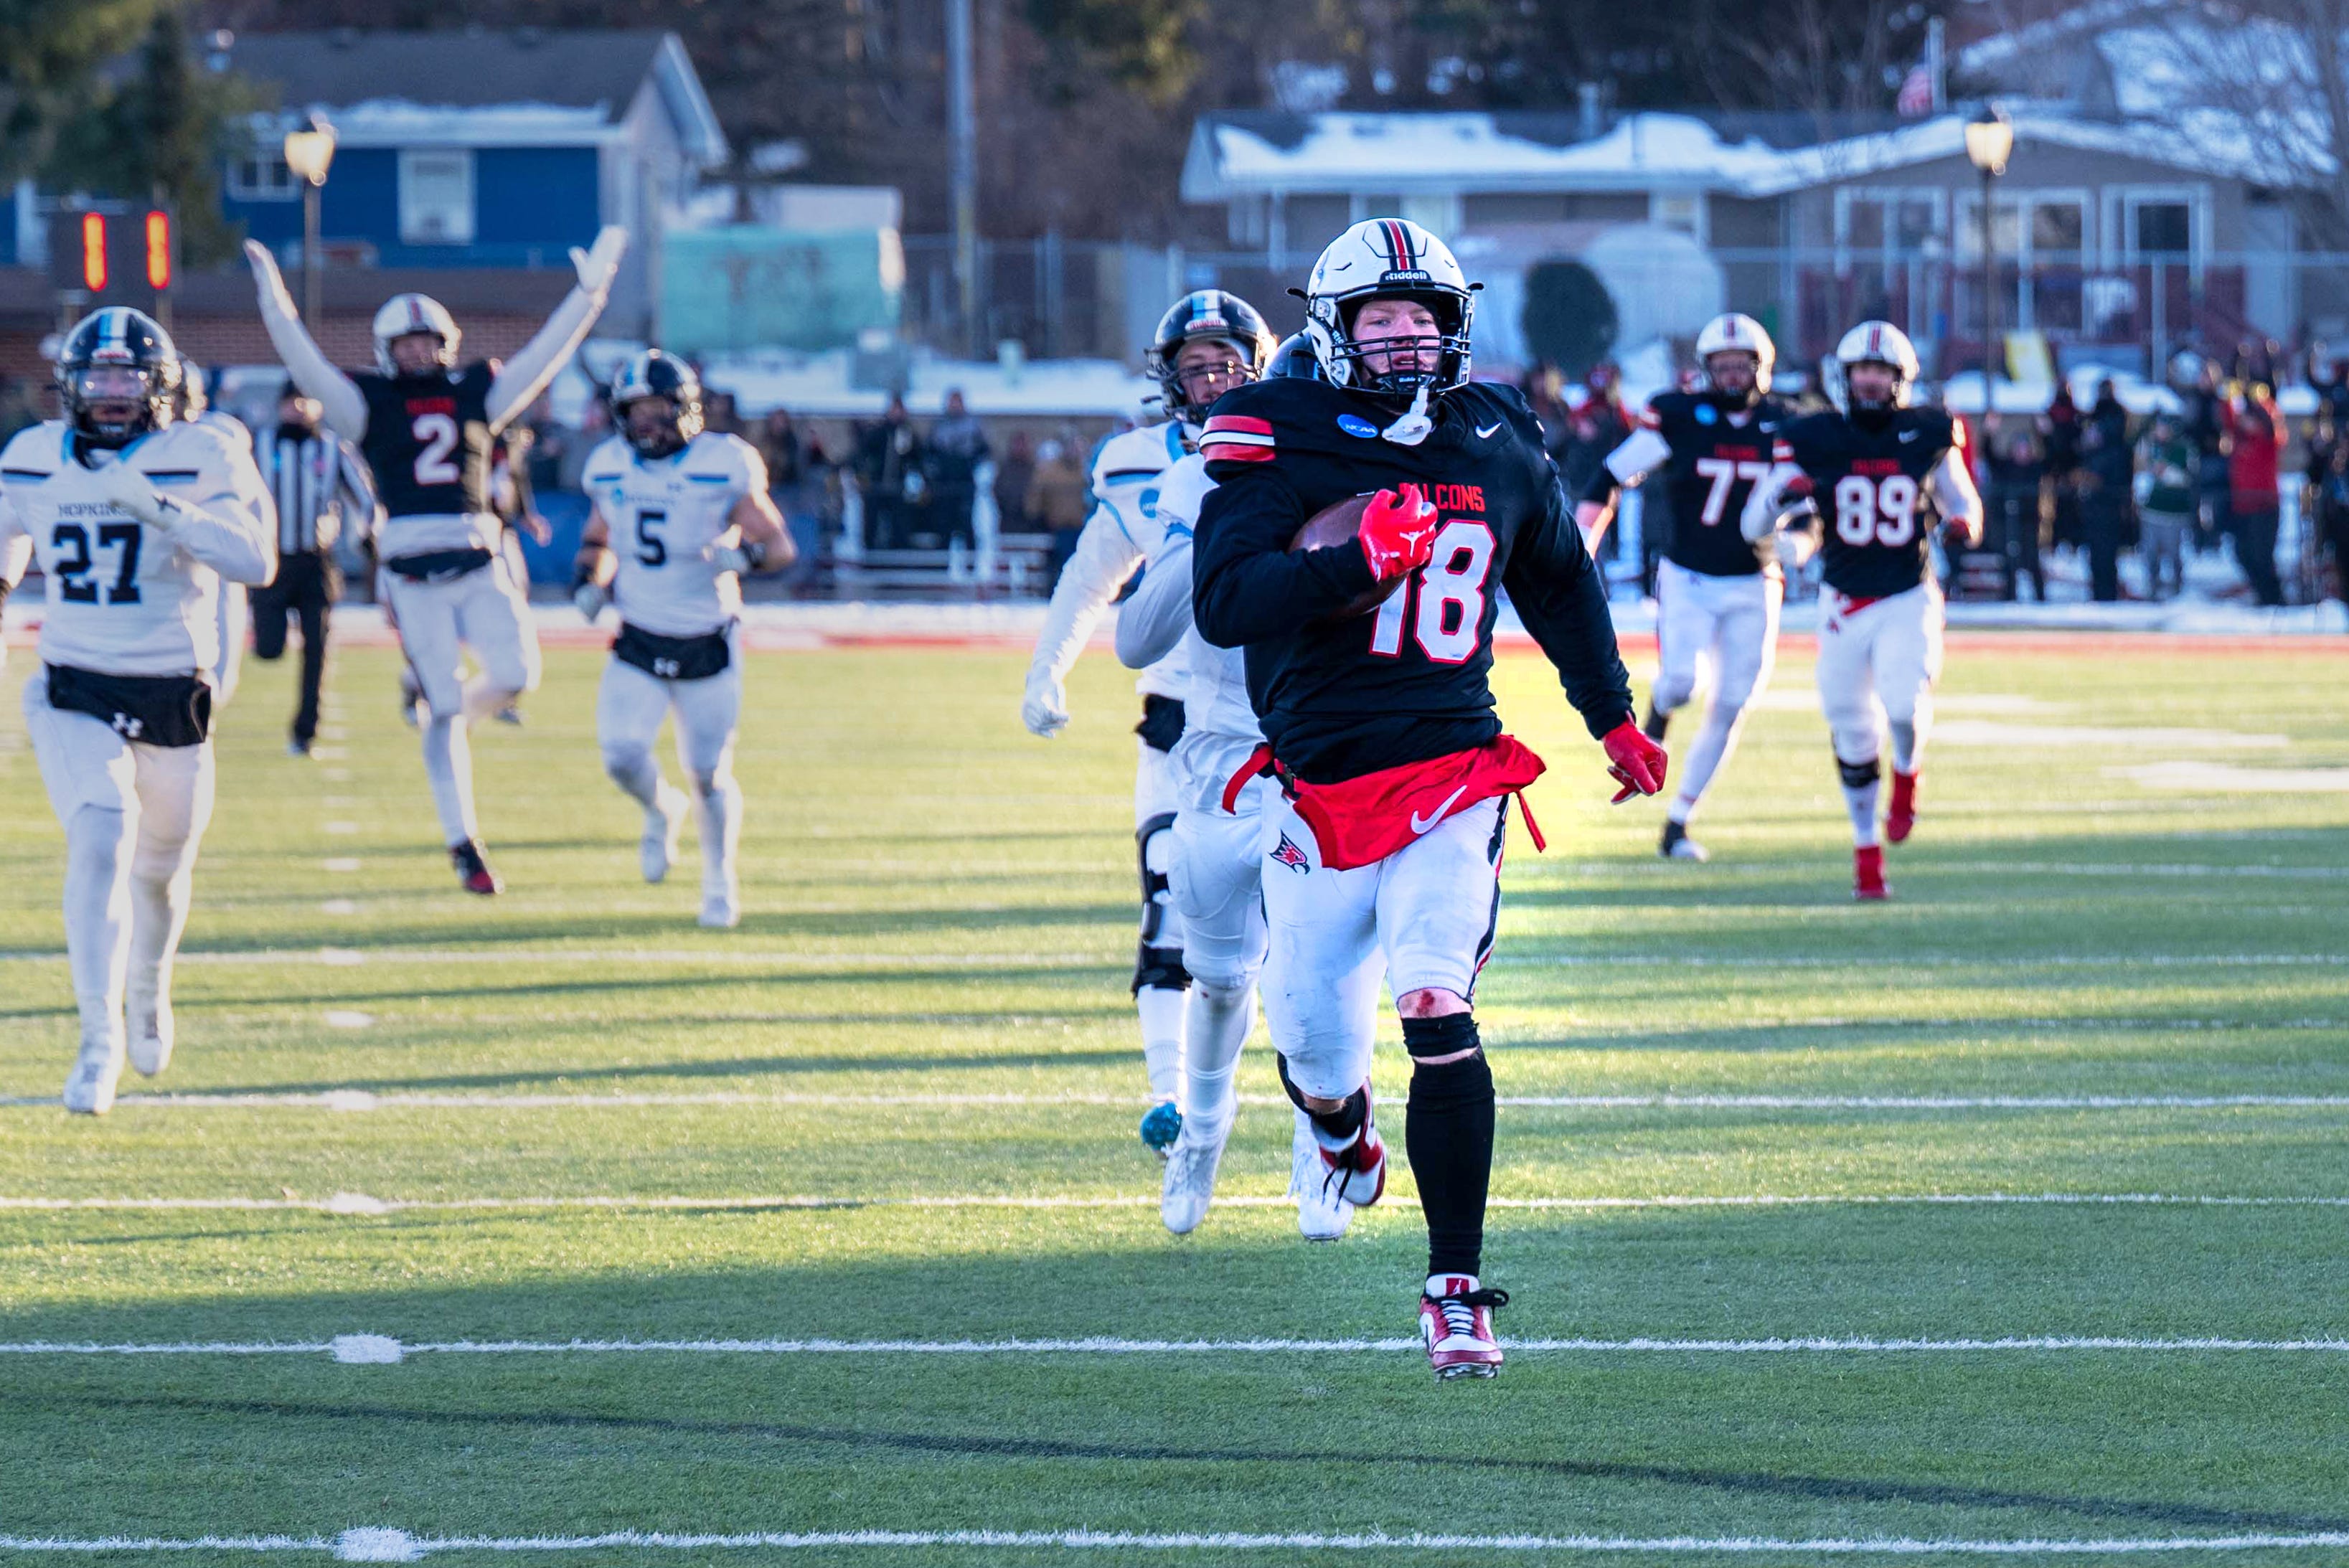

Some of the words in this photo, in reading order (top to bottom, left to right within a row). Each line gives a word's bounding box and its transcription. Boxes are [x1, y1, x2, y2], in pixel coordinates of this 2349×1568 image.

[412, 412, 460, 486] 2
[1696, 457, 1772, 526] 77
[1835, 474, 1919, 547] 89
[52, 523, 143, 605] 27
[634, 509, 668, 568] 5
[1369, 519, 1497, 665] 18
